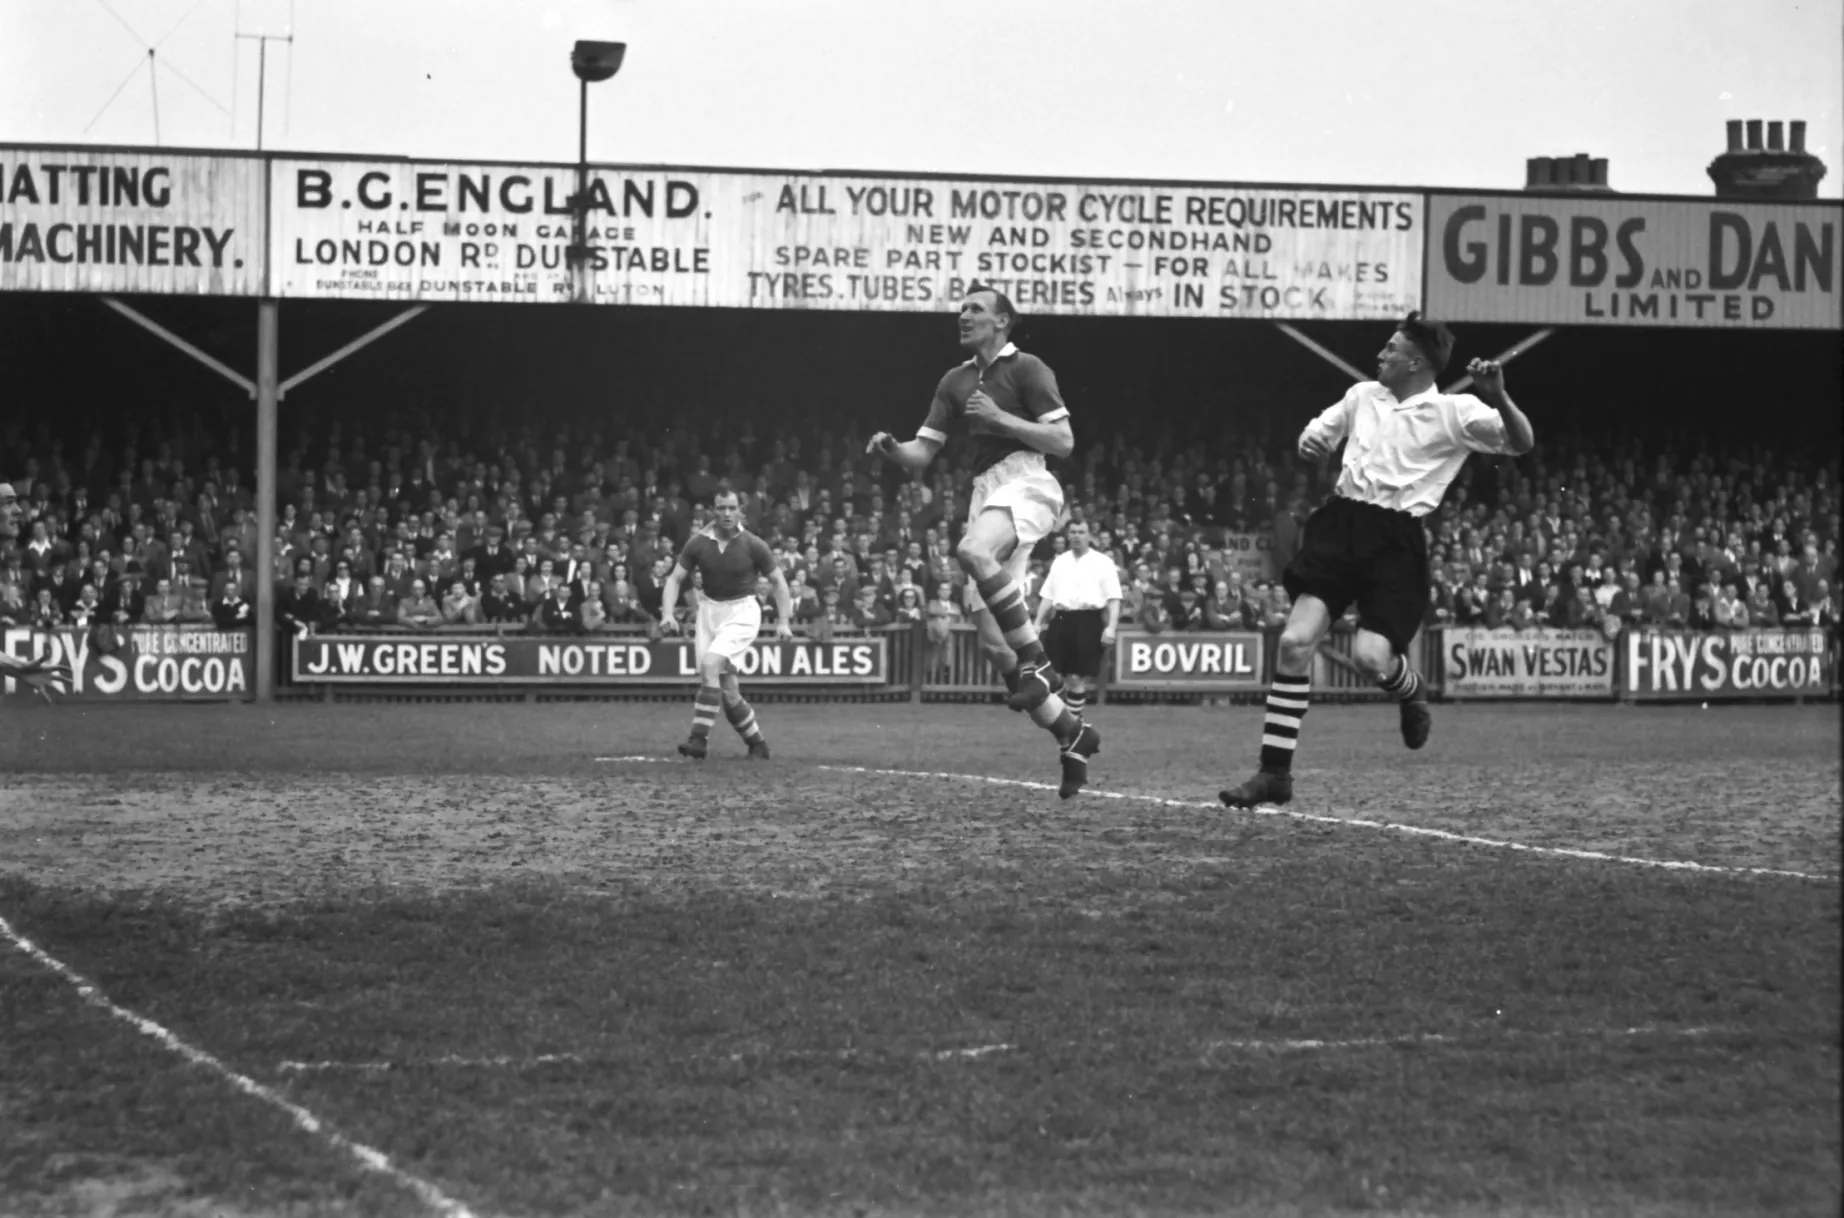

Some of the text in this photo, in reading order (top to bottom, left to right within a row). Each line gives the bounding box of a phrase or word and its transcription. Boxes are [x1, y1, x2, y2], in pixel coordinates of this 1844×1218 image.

[0, 162, 171, 208] ATTING
[775, 183, 1414, 232] ALL YOUR MOTOR CYCLE REQUIREMENTS
[357, 219, 636, 242] HALF MOON GAAGE
[907, 224, 1273, 254] NEW AND SECONDHAND
[295, 237, 441, 268] LONDON
[775, 246, 870, 269] SPARE
[886, 249, 963, 271] PART
[977, 251, 1113, 276] STOCKIST
[1154, 256, 1209, 278] FOR
[1225, 259, 1278, 280] ALL
[1443, 205, 1835, 294] GIBBS AND DAN
[421, 279, 538, 295] DUNSTABLE
[597, 283, 665, 297] LUTON
[1175, 283, 1204, 309] IN
[1219, 285, 1328, 311] STOCK
[1585, 292, 1775, 321] LIMITED
[134, 653, 246, 693] COCOA
[538, 644, 652, 676] NOTED
[679, 645, 783, 676] LON
[790, 645, 874, 676] ALES
[1131, 641, 1253, 674] BOVRIL
[1451, 643, 1608, 680] SWAN VESTAS
[1731, 653, 1822, 690] COCOA
